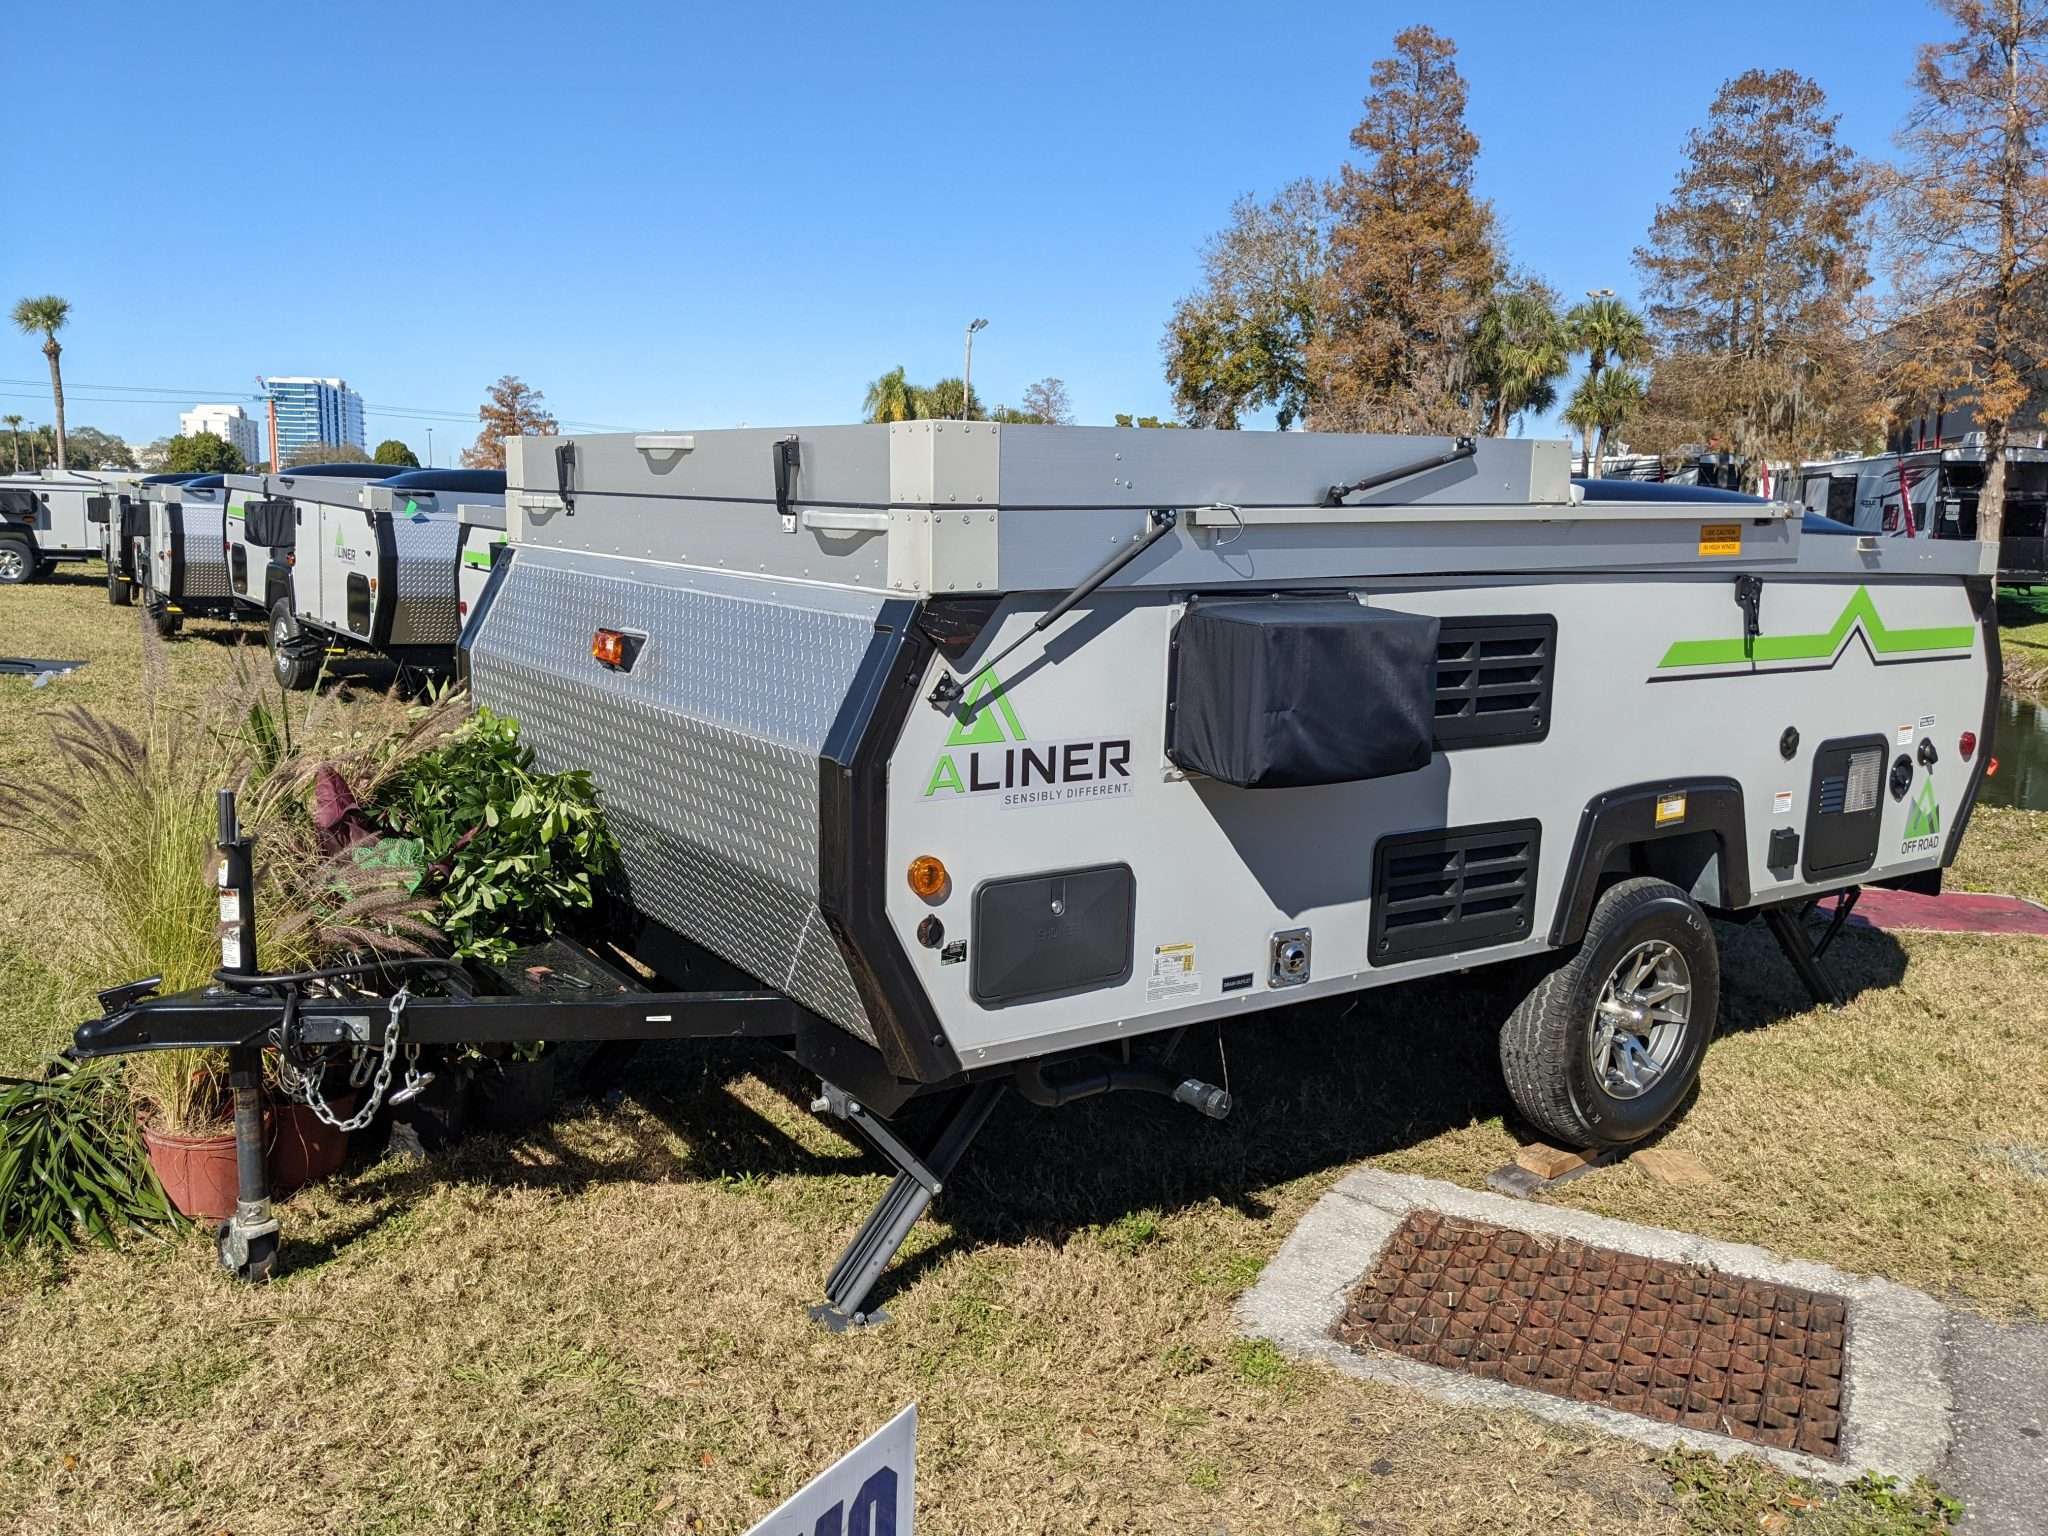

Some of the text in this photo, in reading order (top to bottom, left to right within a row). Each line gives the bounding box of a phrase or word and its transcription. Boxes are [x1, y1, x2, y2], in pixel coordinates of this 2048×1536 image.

[923, 740, 1131, 796] ALINER
[1004, 790, 1062, 805] SENSIBLY
[1902, 836, 1939, 854] OFF ROAD
